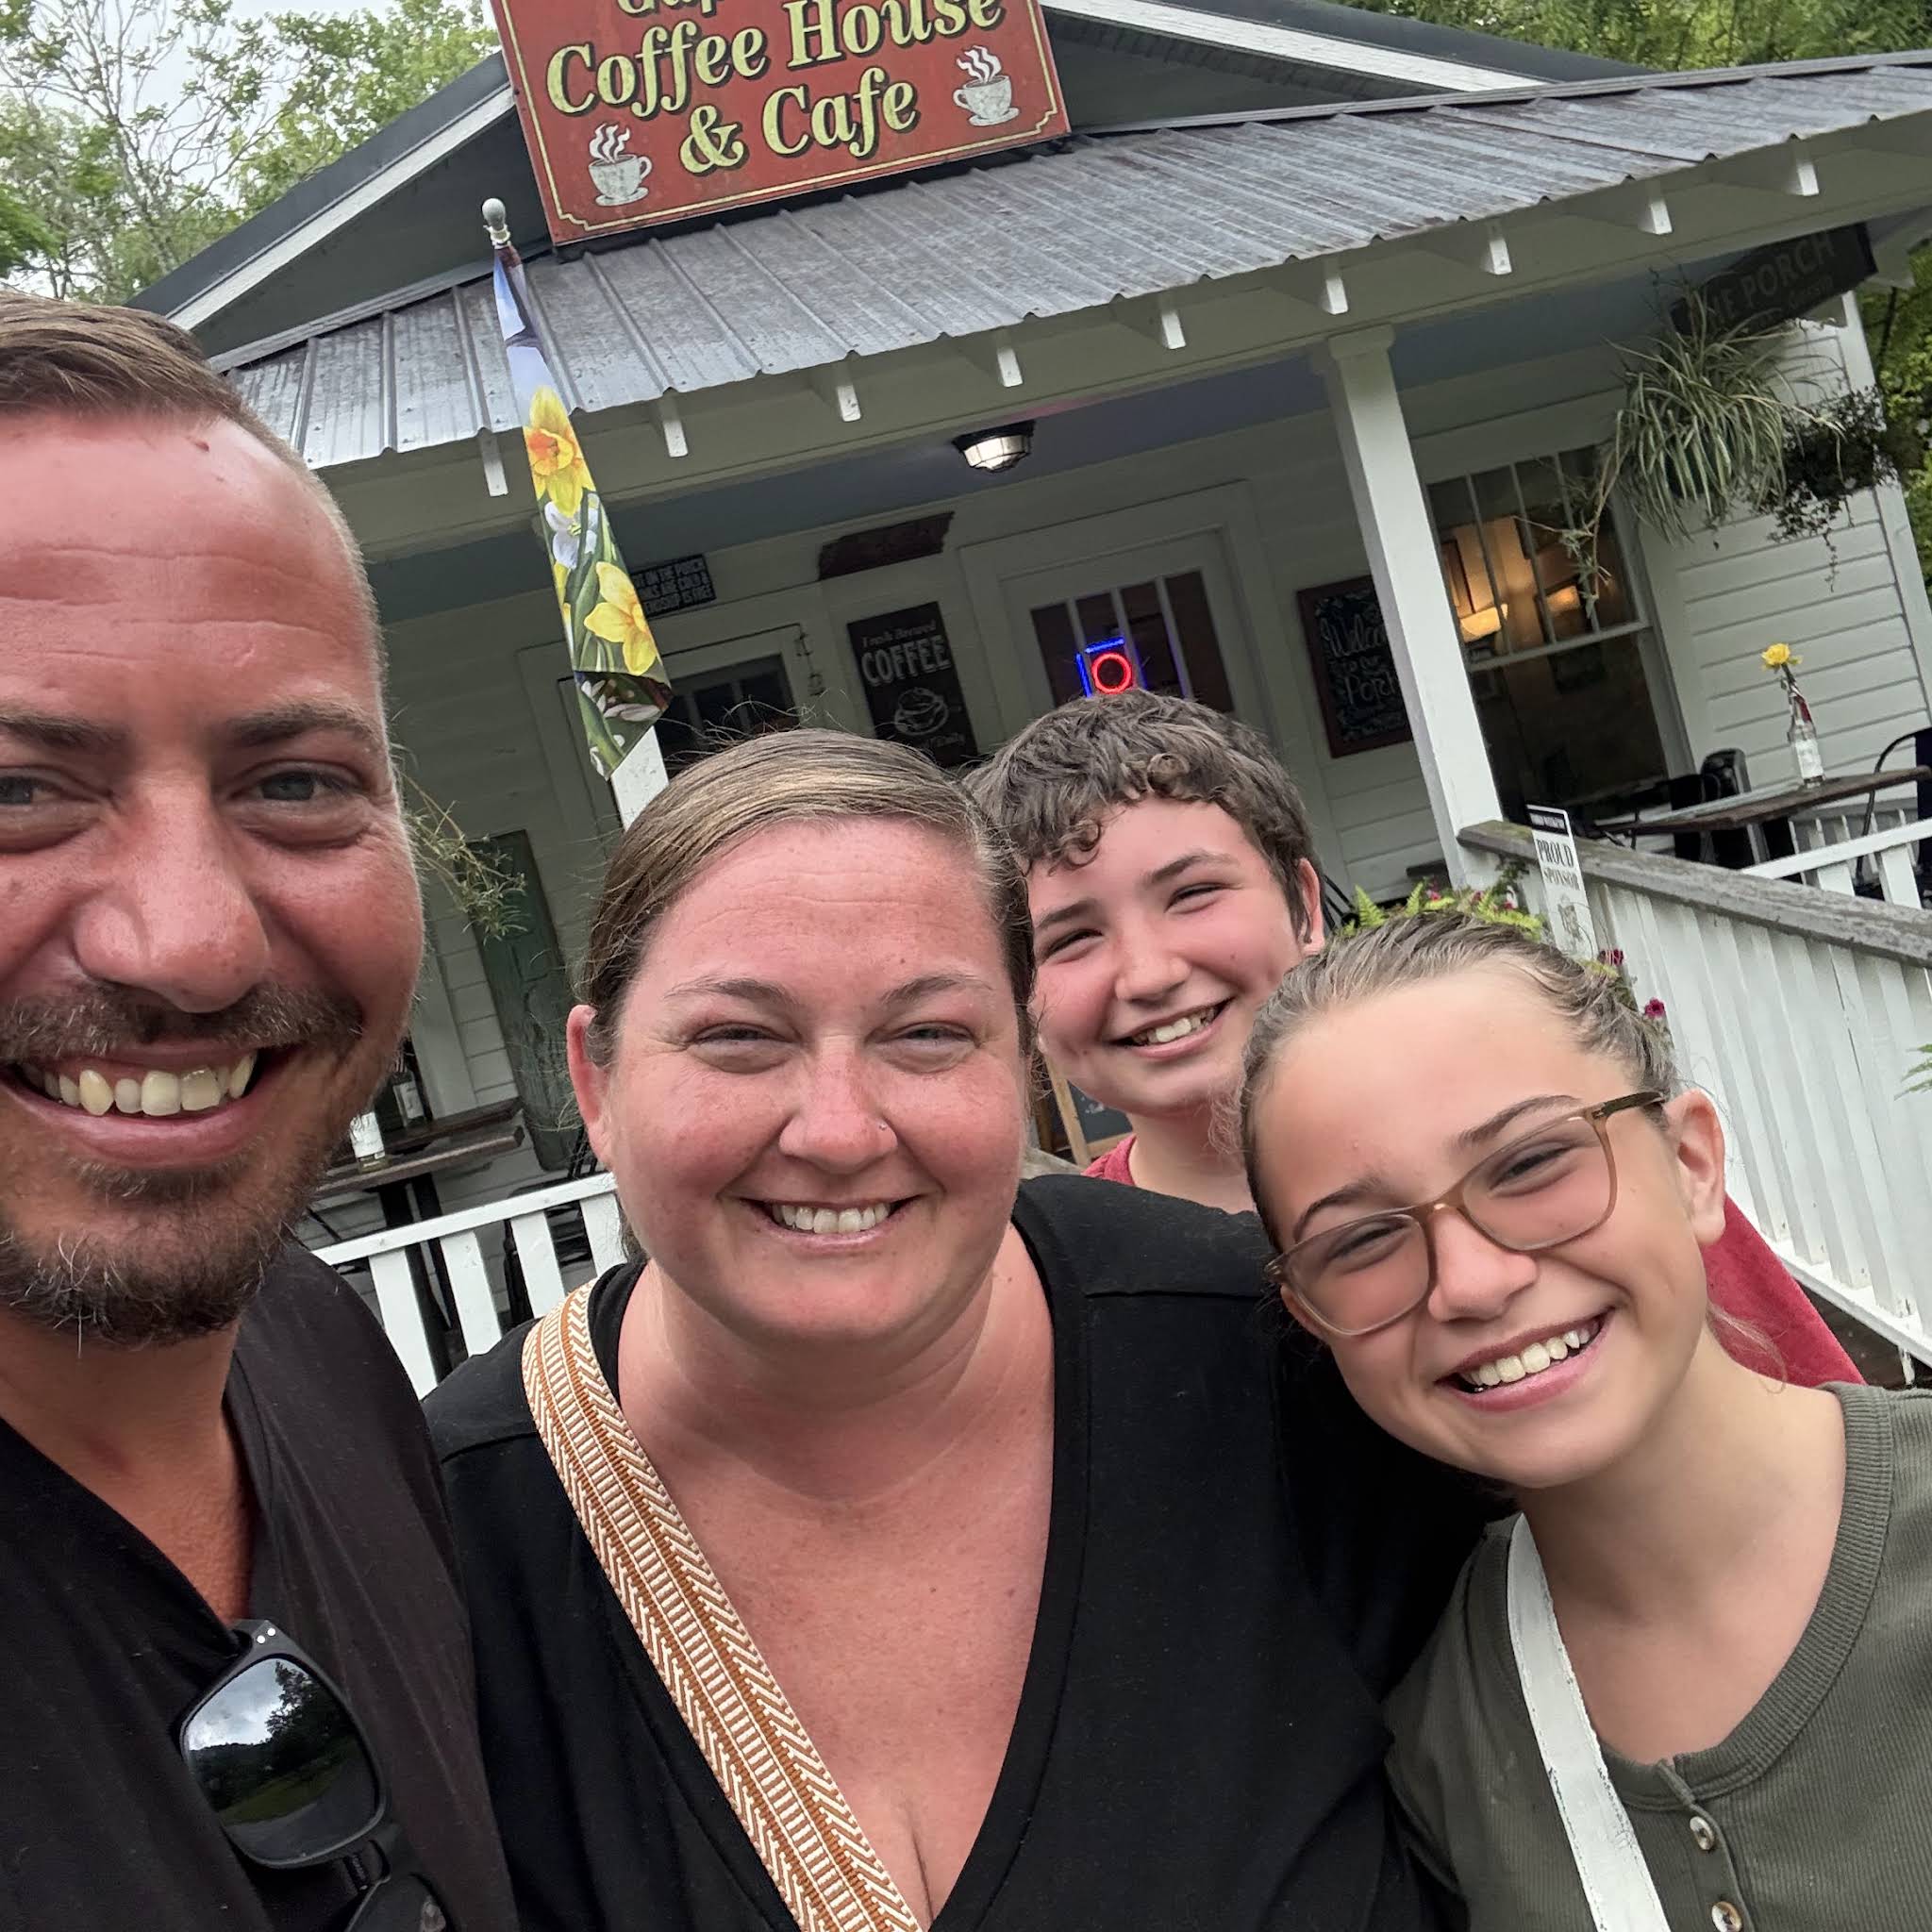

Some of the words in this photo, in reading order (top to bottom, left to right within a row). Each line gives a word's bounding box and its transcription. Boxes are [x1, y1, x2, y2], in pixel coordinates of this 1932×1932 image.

[547, 20, 768, 119] Coffee
[782, 0, 1005, 69] House
[679, 104, 748, 175] &
[762, 66, 919, 158] Cafe
[1740, 236, 1836, 309] PORCH
[860, 635, 952, 687] COFFEE
[1536, 838, 1574, 867] PROUD
